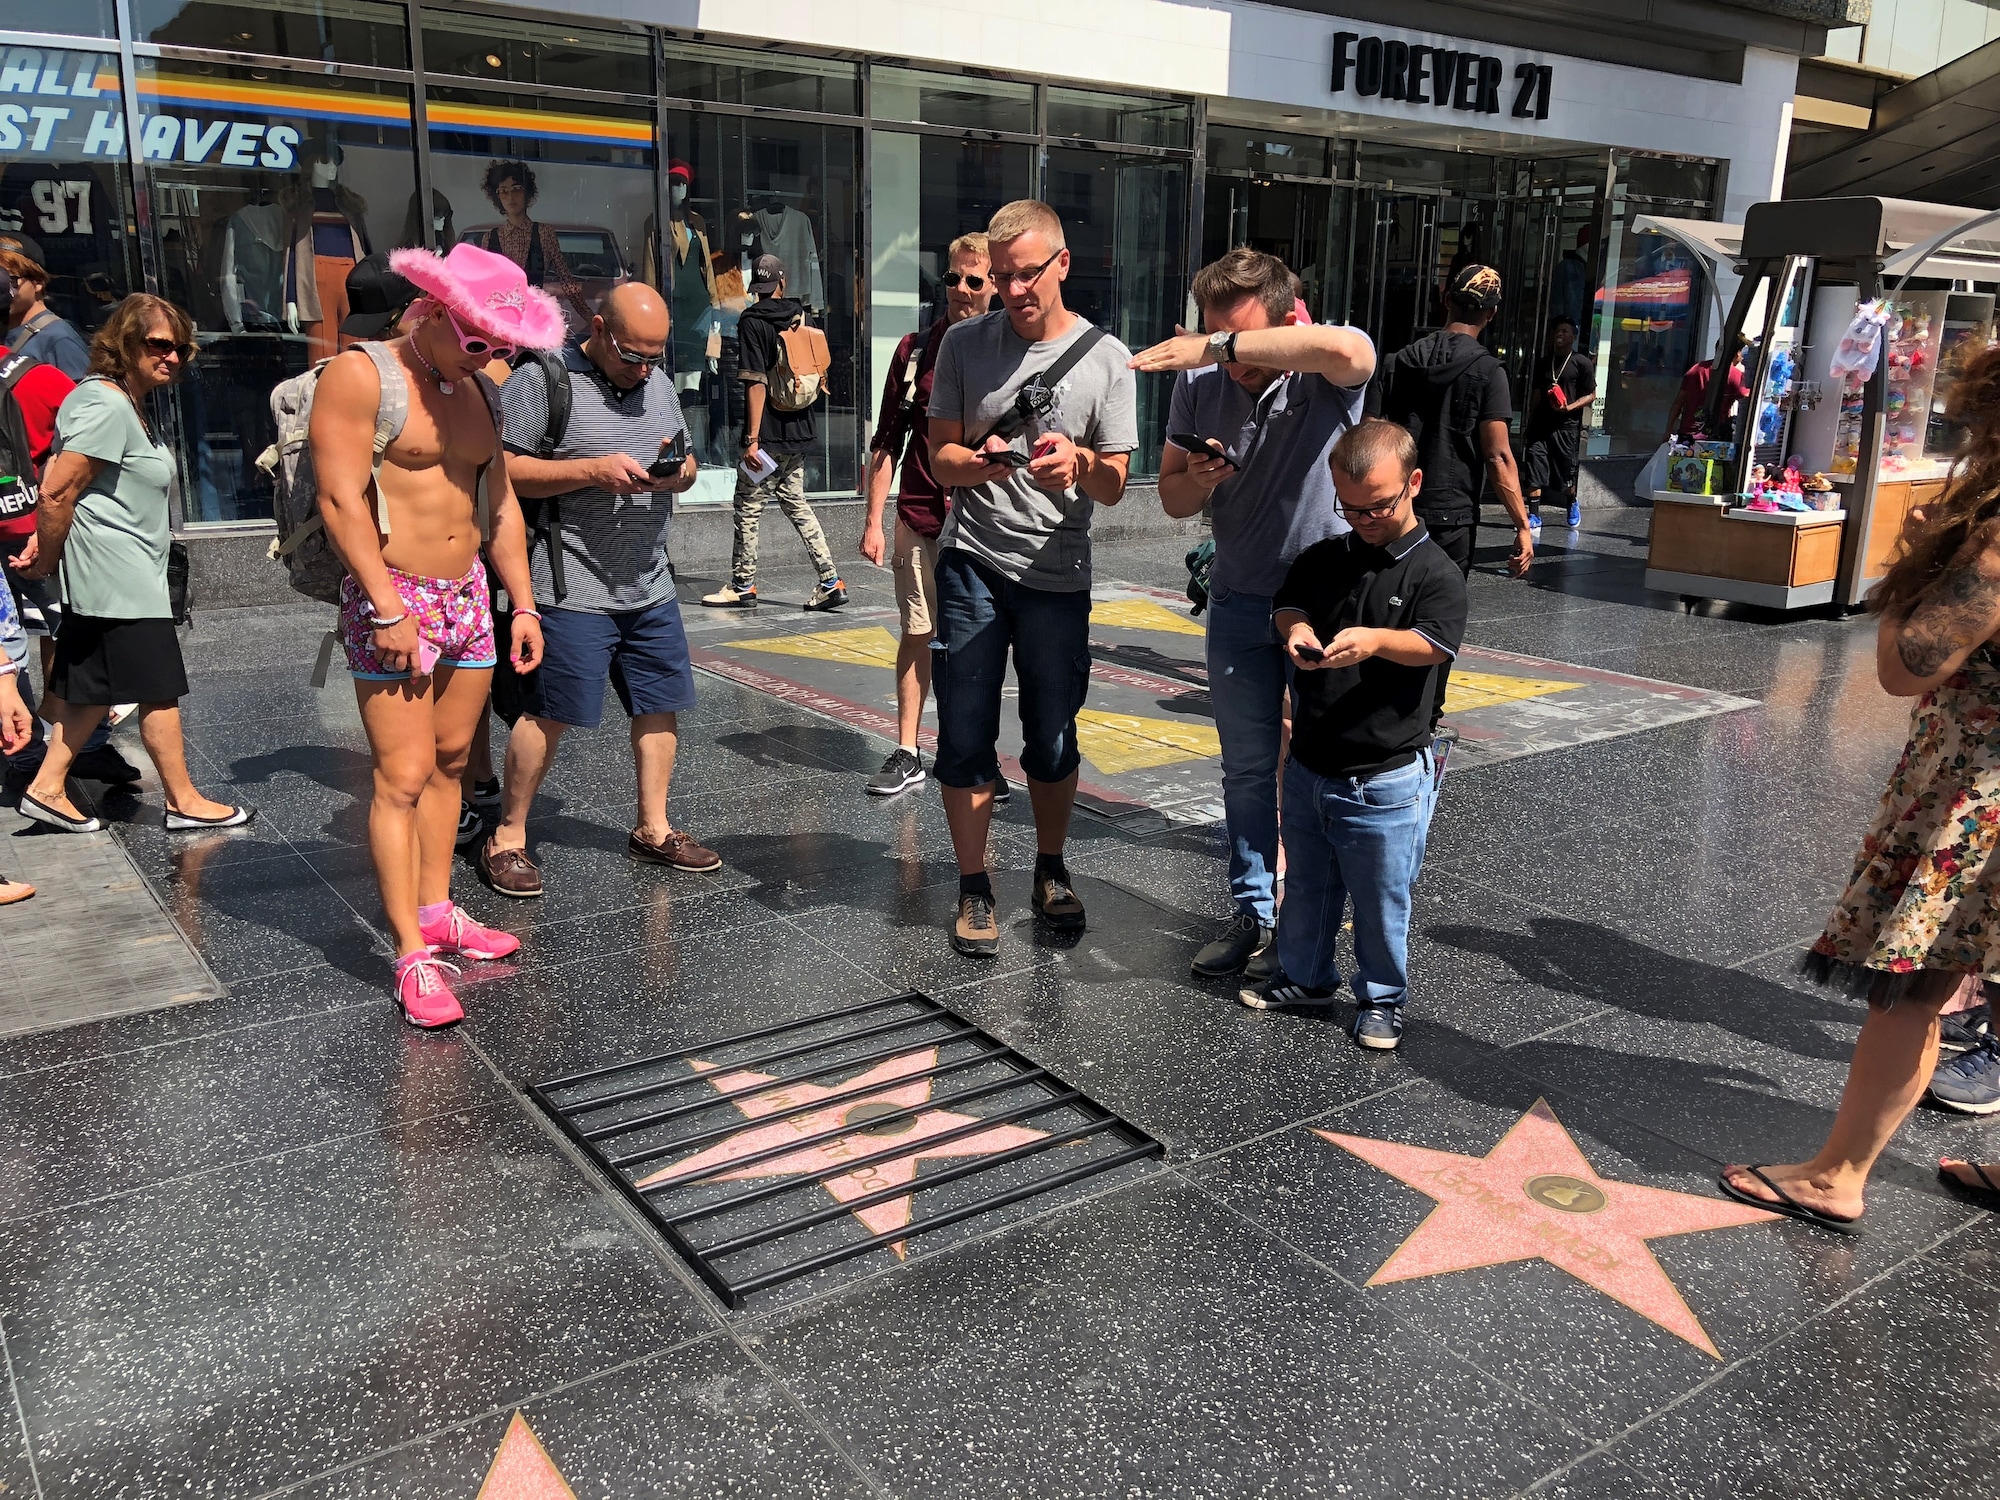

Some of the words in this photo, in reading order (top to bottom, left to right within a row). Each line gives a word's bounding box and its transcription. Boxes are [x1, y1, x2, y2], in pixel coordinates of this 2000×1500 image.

[0, 47, 101, 97] ALL
[1331, 31, 1503, 114] FOREVER
[1511, 62, 1553, 120] 21
[82, 110, 299, 169] HAVES
[30, 179, 94, 235] 97
[1109, 673, 1164, 689] OPEN
[807, 698, 855, 711] MAY
[843, 710, 899, 729] OPEN
[1420, 1167, 1524, 1221] SPACEY
[1531, 1220, 1624, 1271] KEVIN
